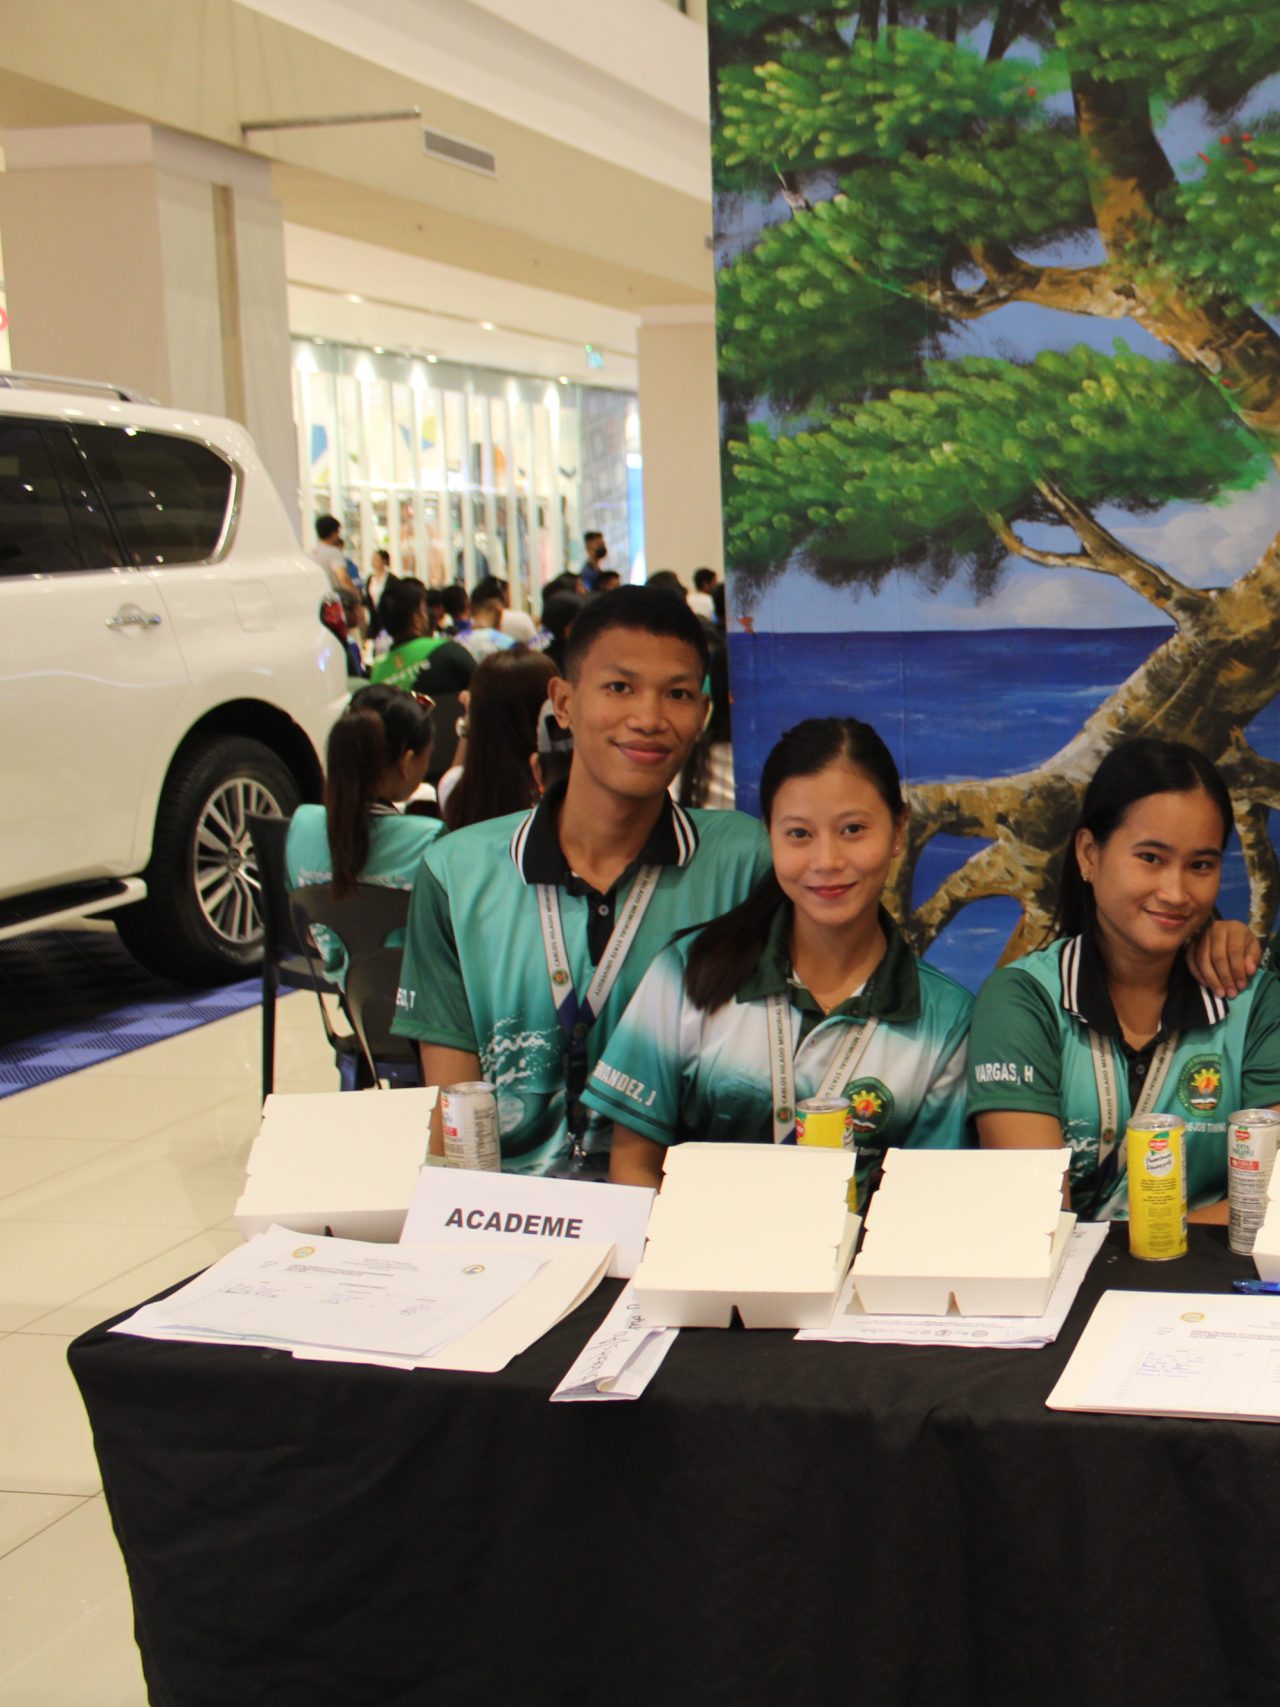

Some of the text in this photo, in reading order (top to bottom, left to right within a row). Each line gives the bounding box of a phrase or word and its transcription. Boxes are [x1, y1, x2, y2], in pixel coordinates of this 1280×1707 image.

[974, 1062, 1034, 1086] VARGAS, H
[444, 1207, 584, 1240] ACADEME
